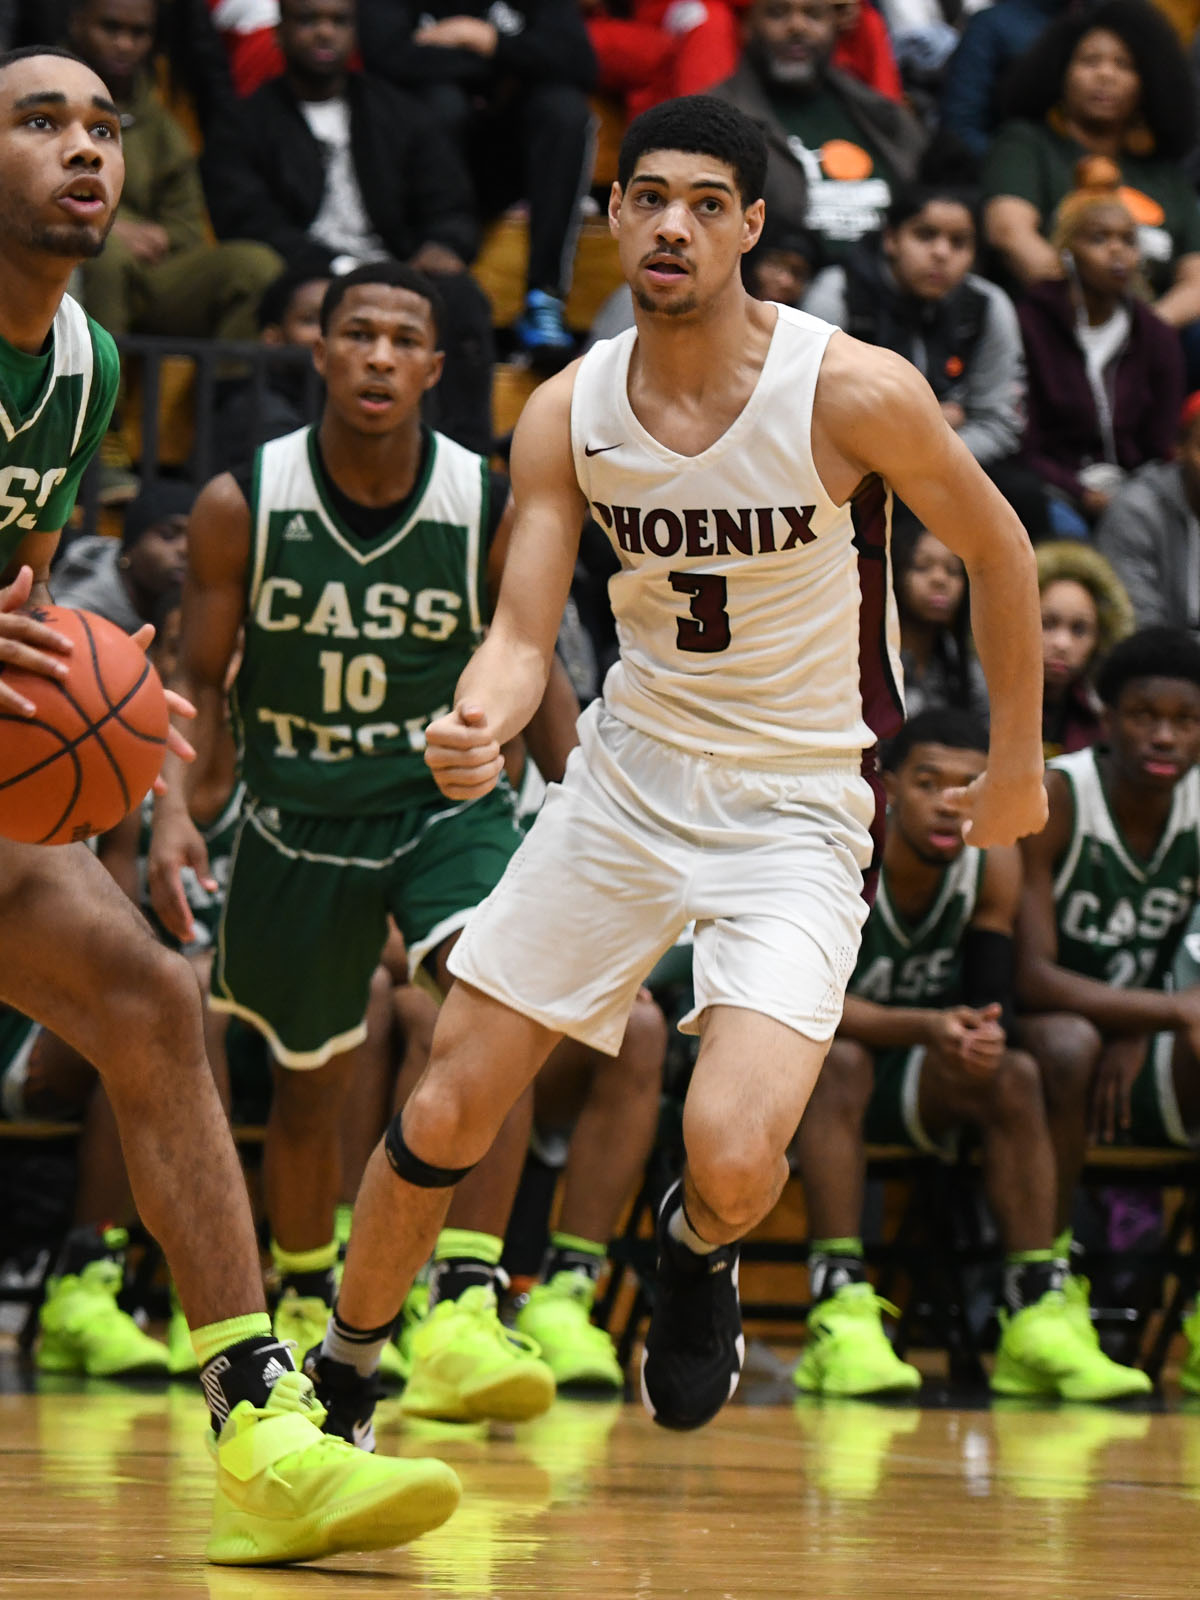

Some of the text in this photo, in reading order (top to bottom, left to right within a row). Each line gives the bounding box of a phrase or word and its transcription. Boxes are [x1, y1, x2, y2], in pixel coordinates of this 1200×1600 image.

[255, 576, 462, 641] CASS
[667, 571, 732, 653] 3
[319, 650, 387, 714] 10
[855, 948, 955, 1001] ASS
